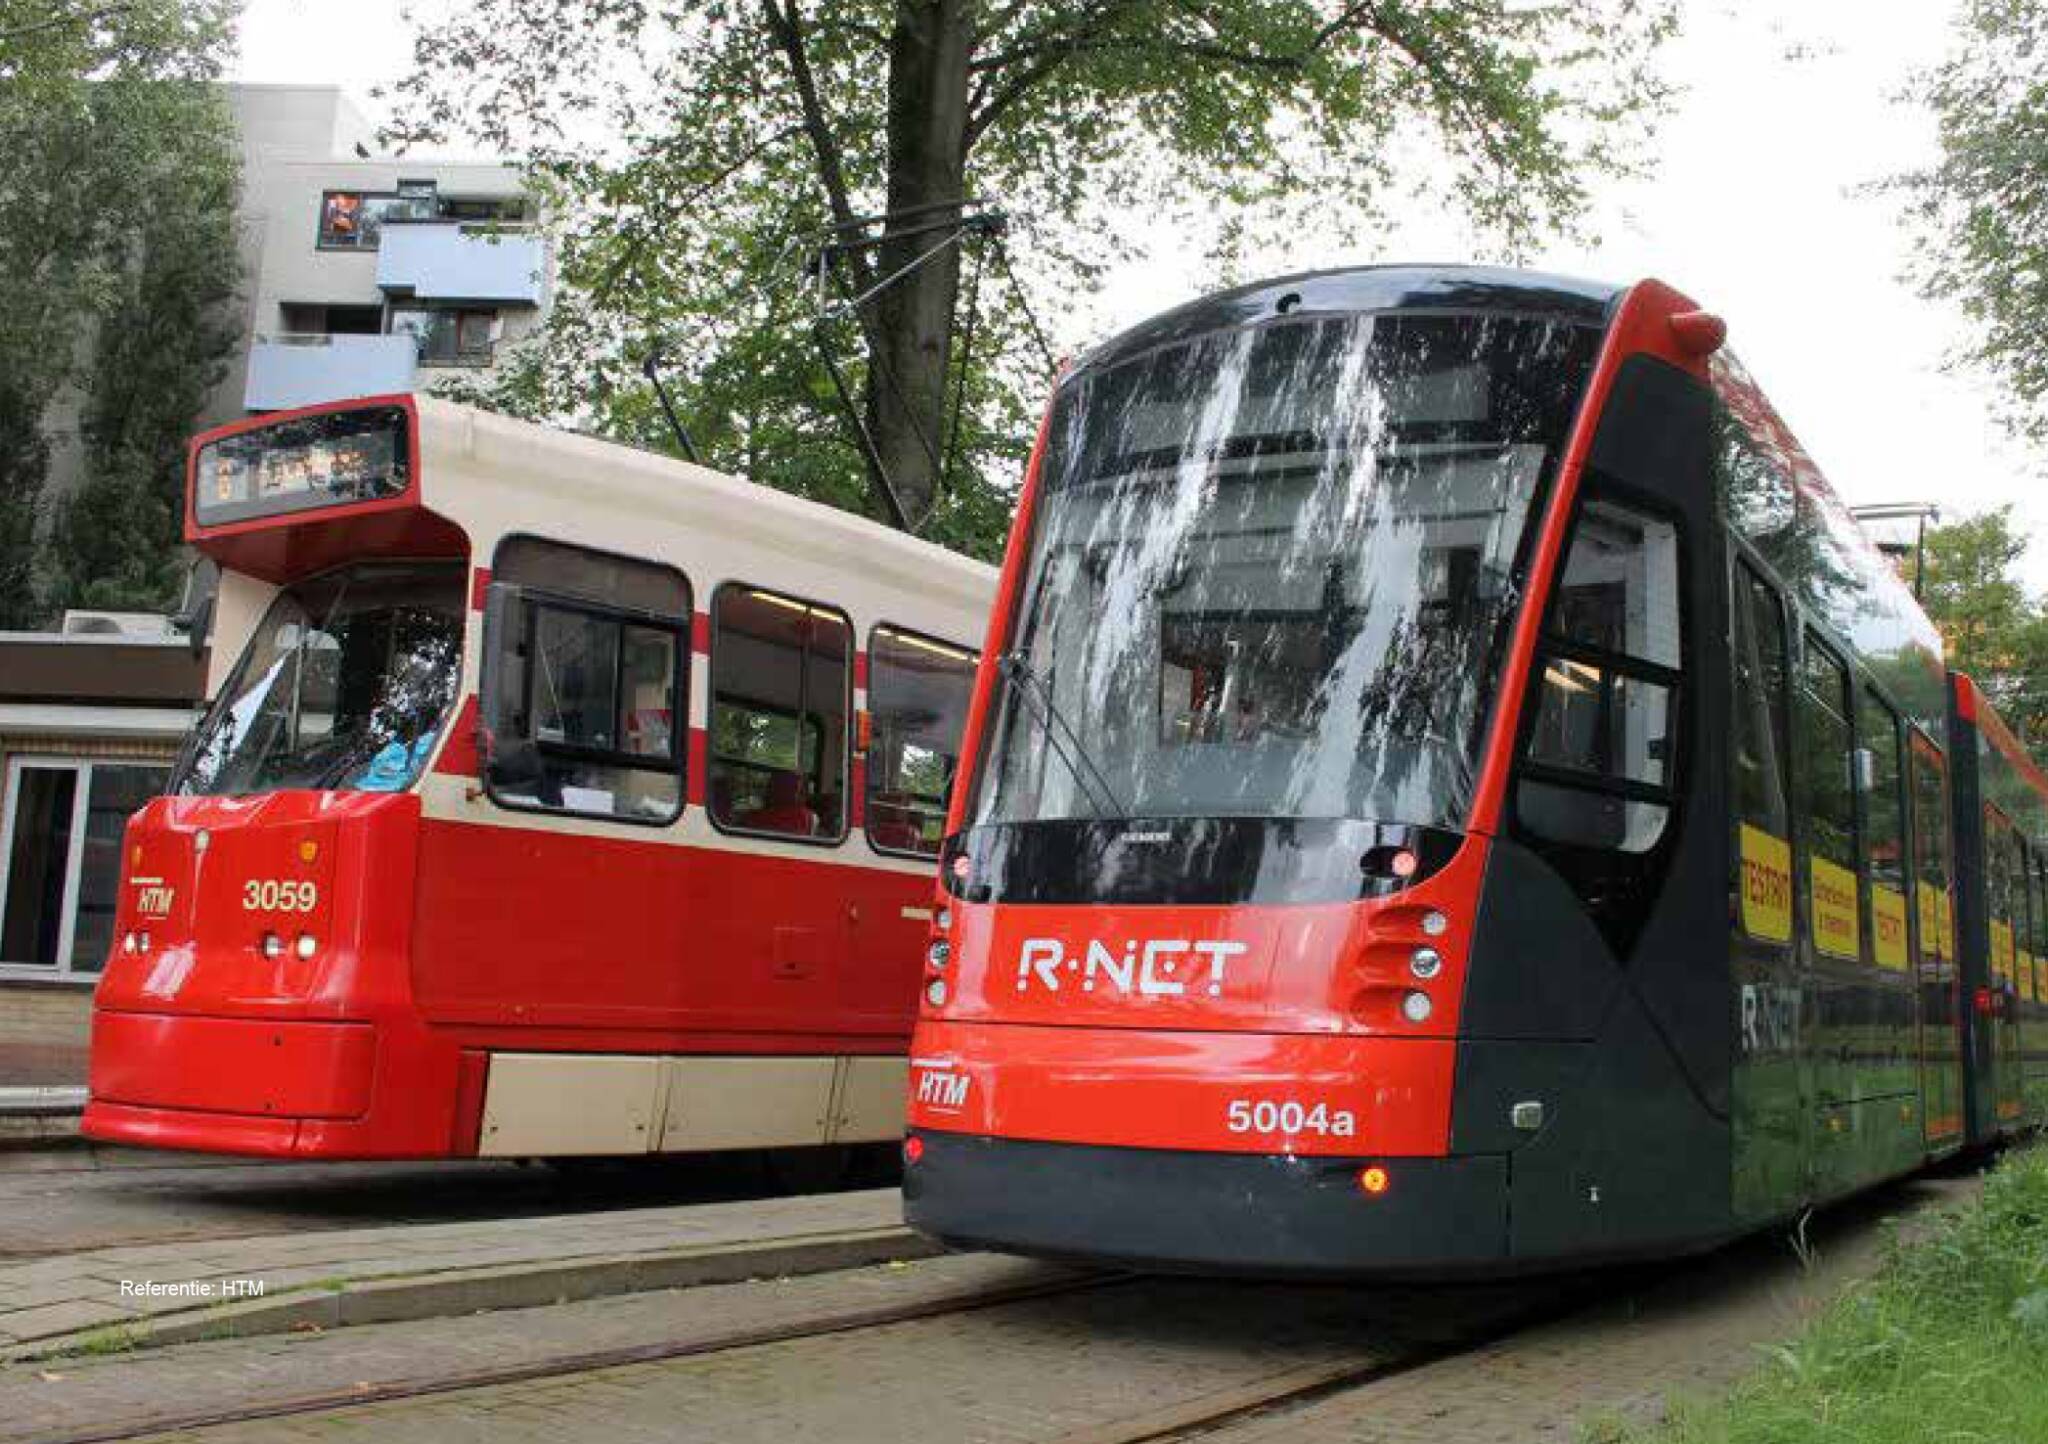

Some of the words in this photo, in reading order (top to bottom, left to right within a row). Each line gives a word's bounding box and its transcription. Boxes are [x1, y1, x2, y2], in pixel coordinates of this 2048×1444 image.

[136, 887, 175, 913] HTM
[242, 879, 317, 912] 3059
[917, 1071, 971, 1105] HTM
[1227, 1100, 1356, 1136] 5004a
